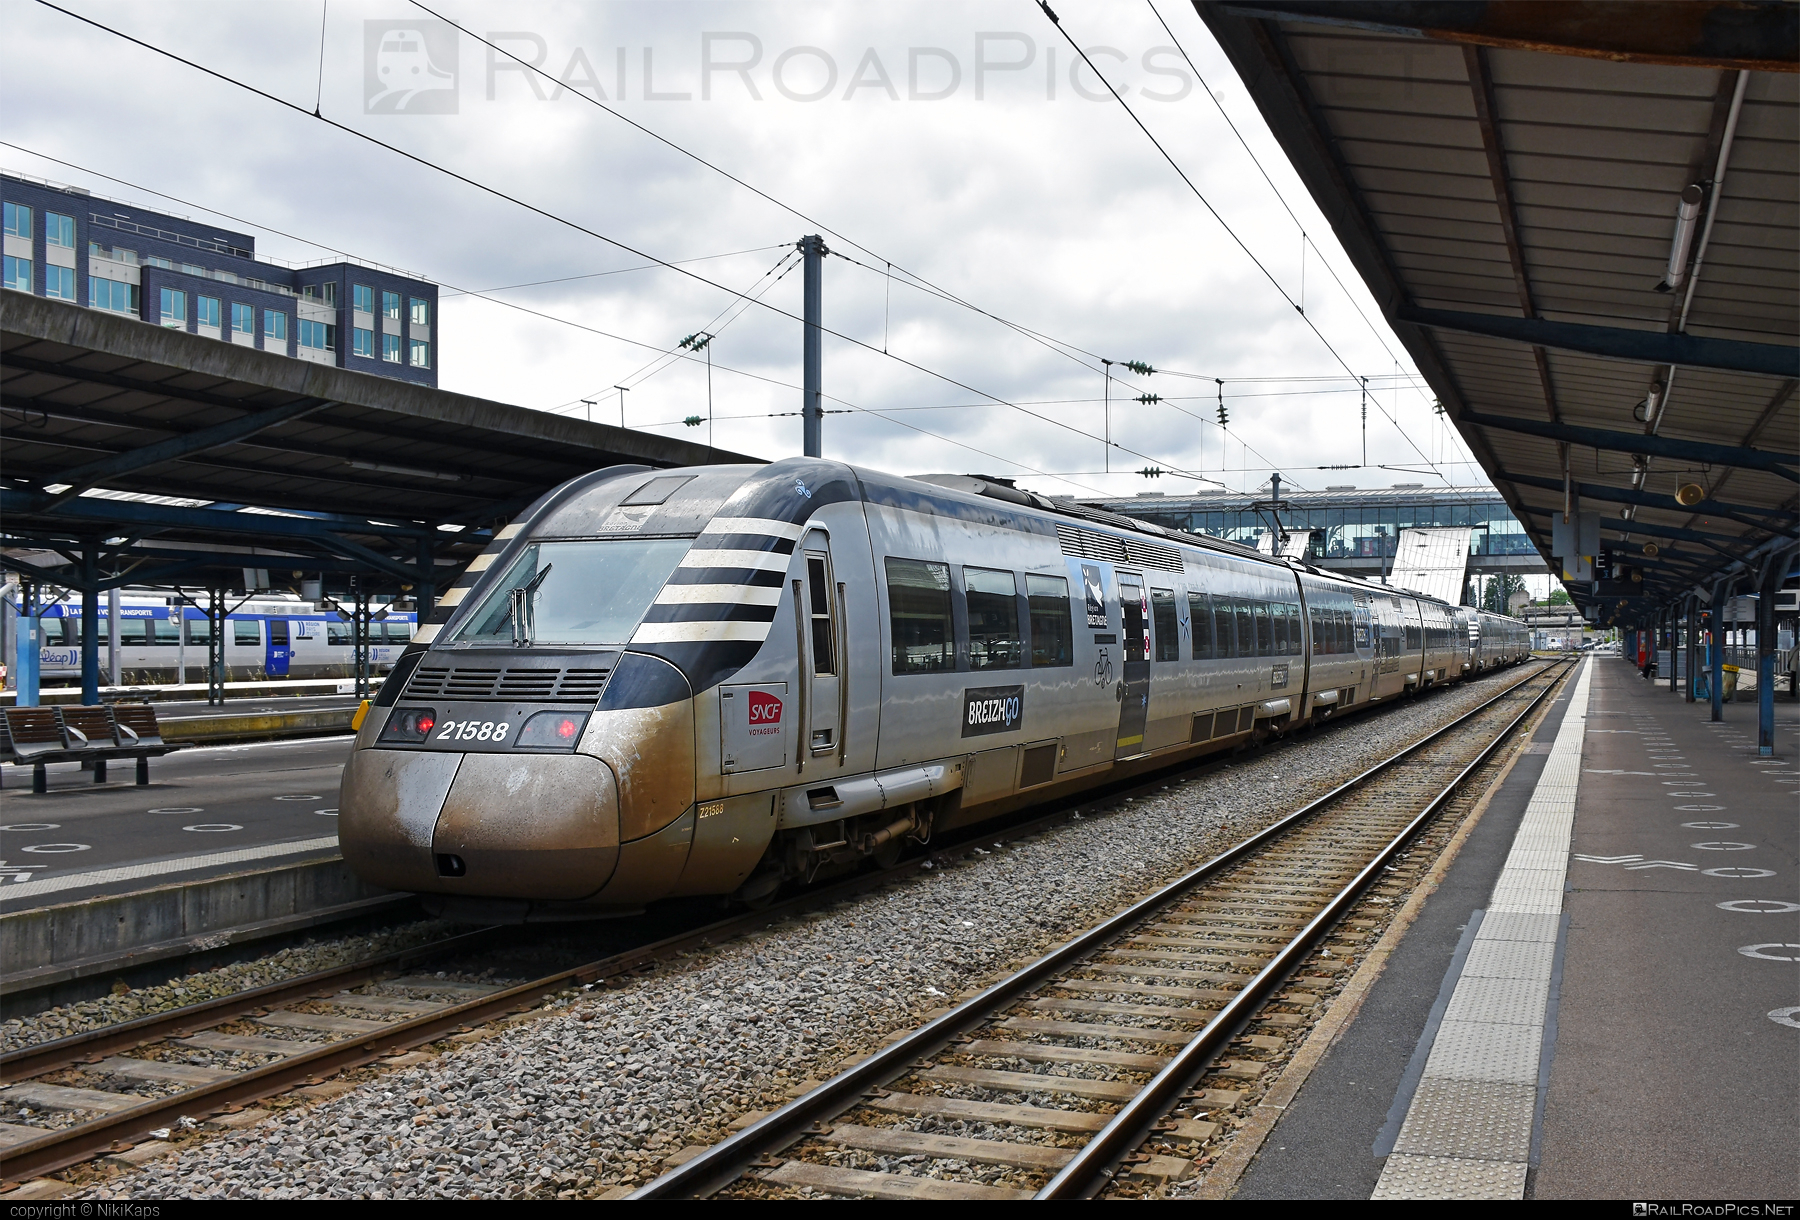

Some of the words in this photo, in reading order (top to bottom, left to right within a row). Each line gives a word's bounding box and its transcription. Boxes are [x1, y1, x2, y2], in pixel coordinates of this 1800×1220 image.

[1596, 554, 1605, 568] E
[350, 576, 356, 587] E
[750, 703, 780, 720] SNCF
[436, 720, 510, 742] 21588
[748, 727, 780, 736] VOYAGEURS
[700, 803, 724, 819] Z21588
